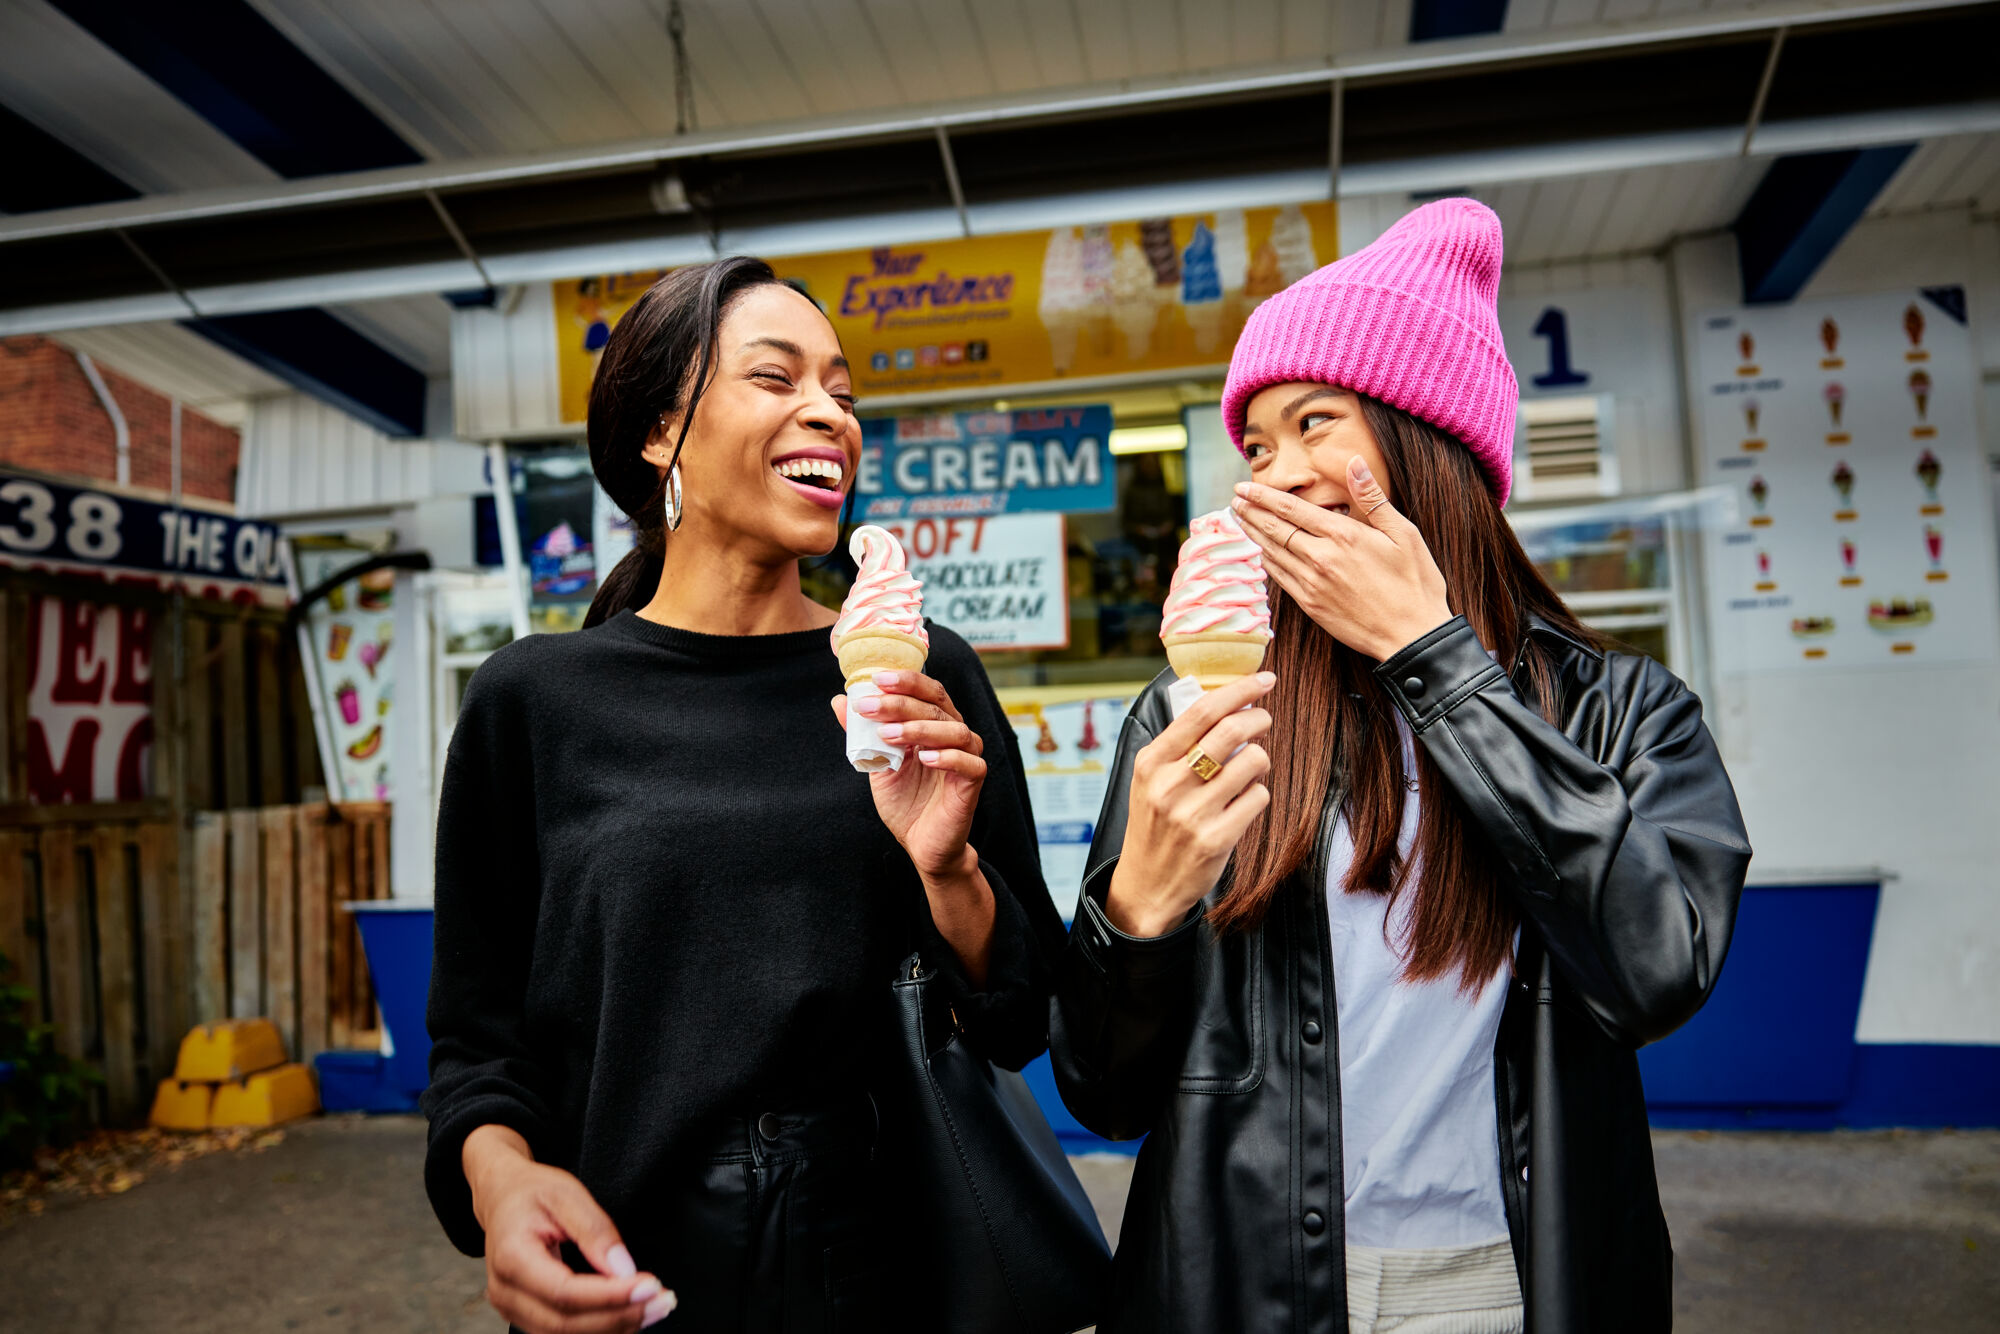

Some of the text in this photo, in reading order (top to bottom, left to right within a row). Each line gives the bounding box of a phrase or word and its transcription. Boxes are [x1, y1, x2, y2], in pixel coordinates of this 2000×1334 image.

[839, 272, 1013, 330] Experience
[1531, 305, 1590, 388] 1
[893, 437, 1099, 493] CREAM
[0, 481, 122, 559] 38
[159, 511, 228, 572] THE
[914, 557, 1044, 592] CHOCOLATE
